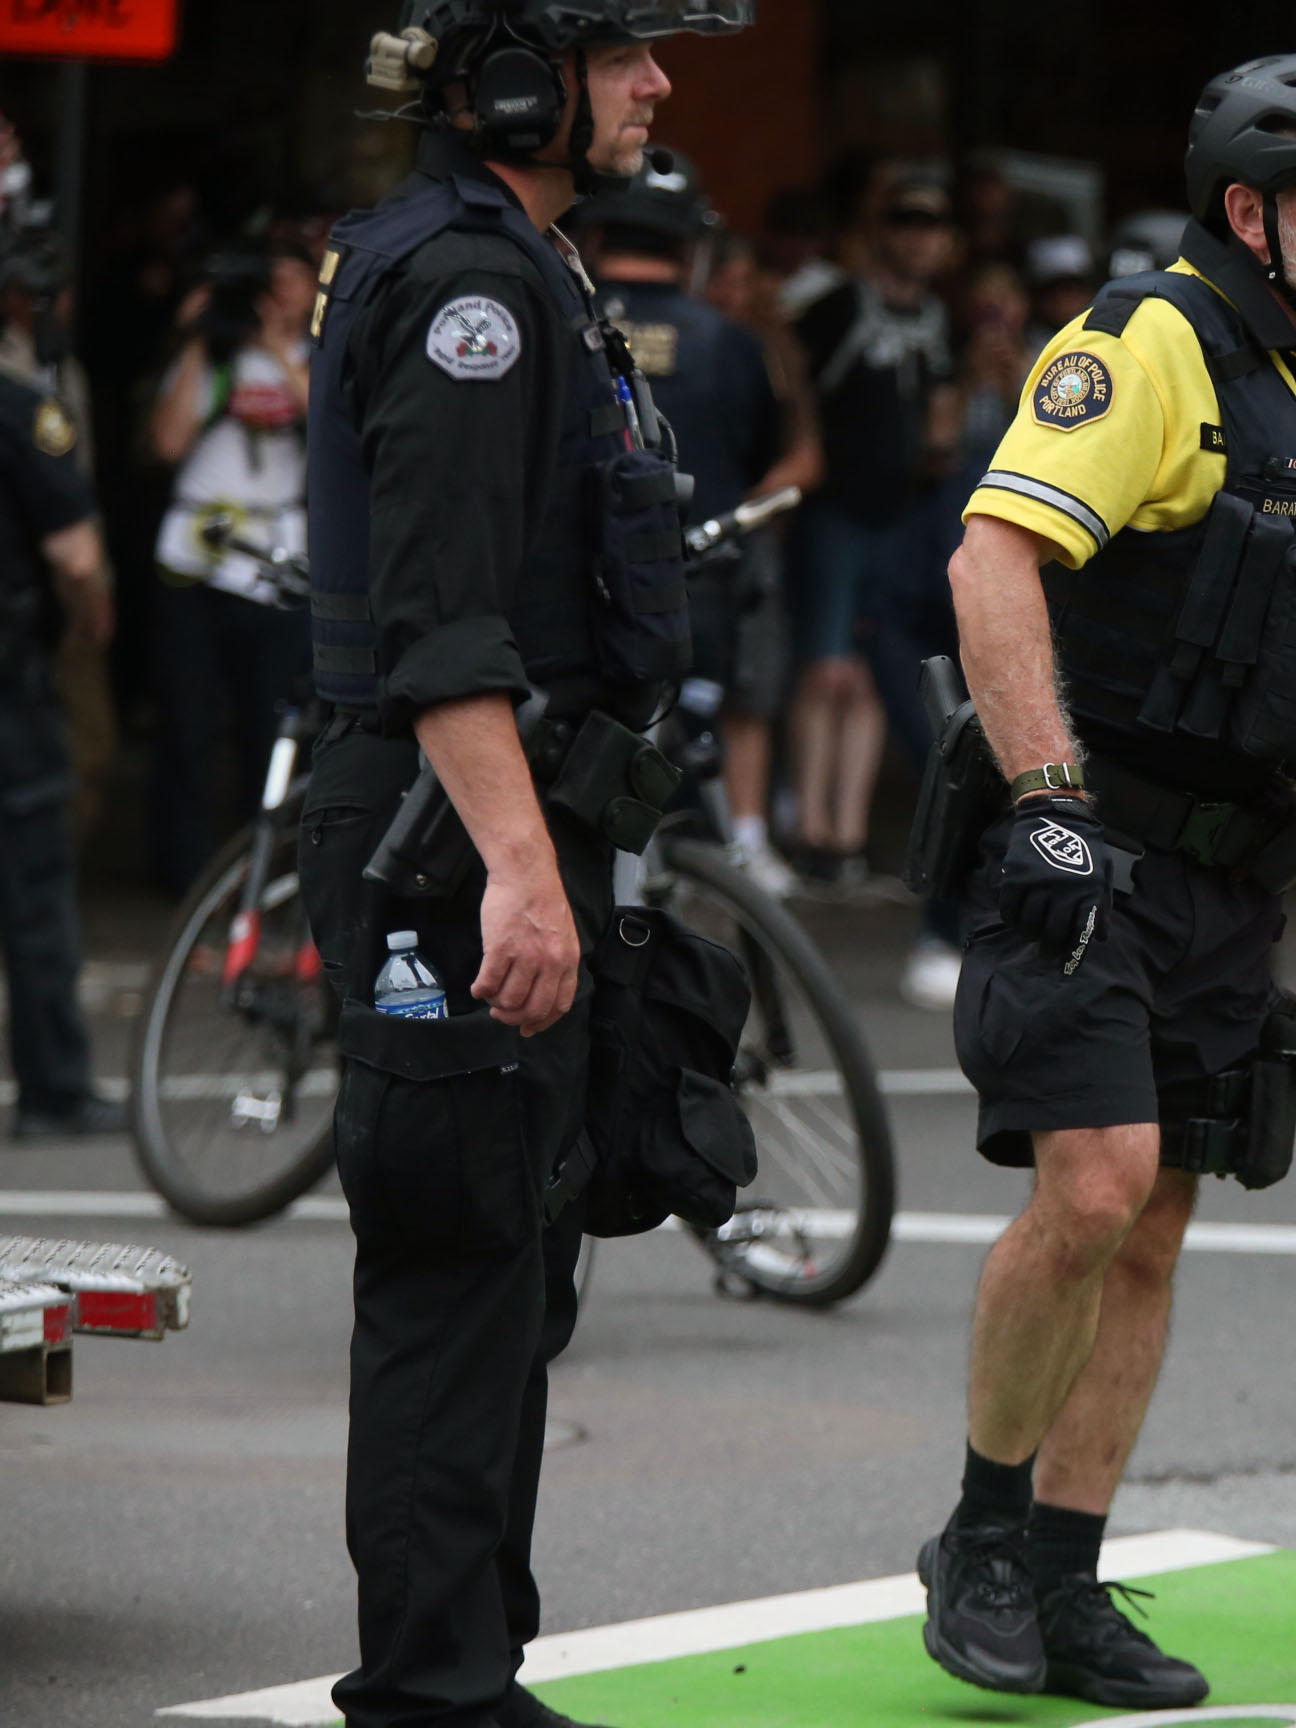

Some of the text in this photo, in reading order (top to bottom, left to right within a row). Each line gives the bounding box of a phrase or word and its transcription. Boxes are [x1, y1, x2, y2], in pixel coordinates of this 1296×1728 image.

[1041, 355, 1107, 402] BUREAU OF POLICE
[1039, 395, 1087, 418] PORTLAND
[1212, 431, 1224, 446] BA
